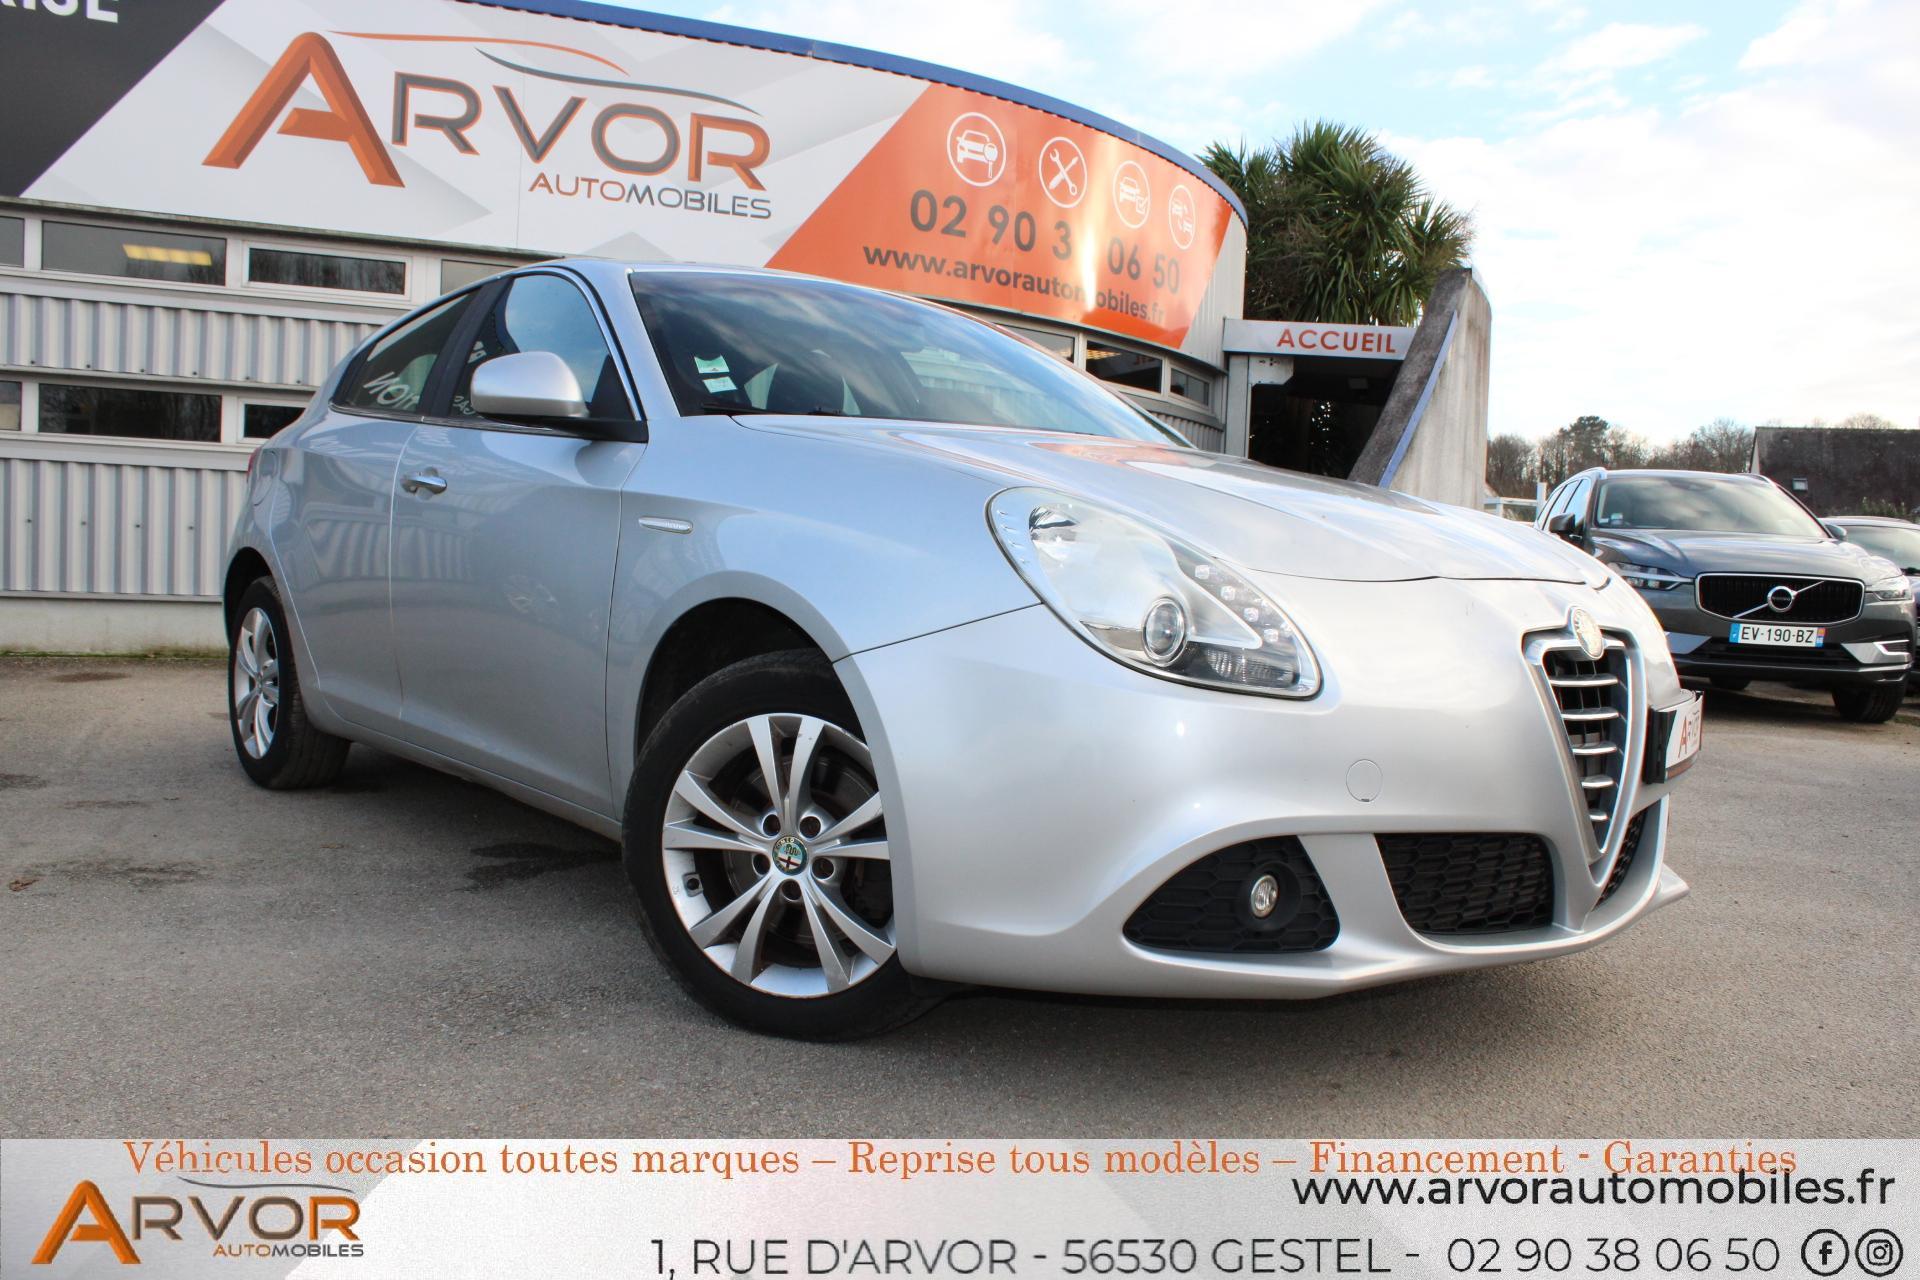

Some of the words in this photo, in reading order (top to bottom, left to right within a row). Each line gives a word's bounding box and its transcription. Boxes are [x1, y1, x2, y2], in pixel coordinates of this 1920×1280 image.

[201, 31, 770, 192] ARVOR
[528, 173, 772, 220] AUTOMOBILES
[910, 189, 967, 238] 02
[988, 204, 1036, 252] 90
[1107, 237, 1141, 281] 06
[1152, 252, 1180, 295] 50
[862, 245, 1165, 325] www.arvorautoobiles.fr
[1276, 328, 1396, 354] ACCUEIL
[1741, 626, 1815, 643] EV-190-BZ
